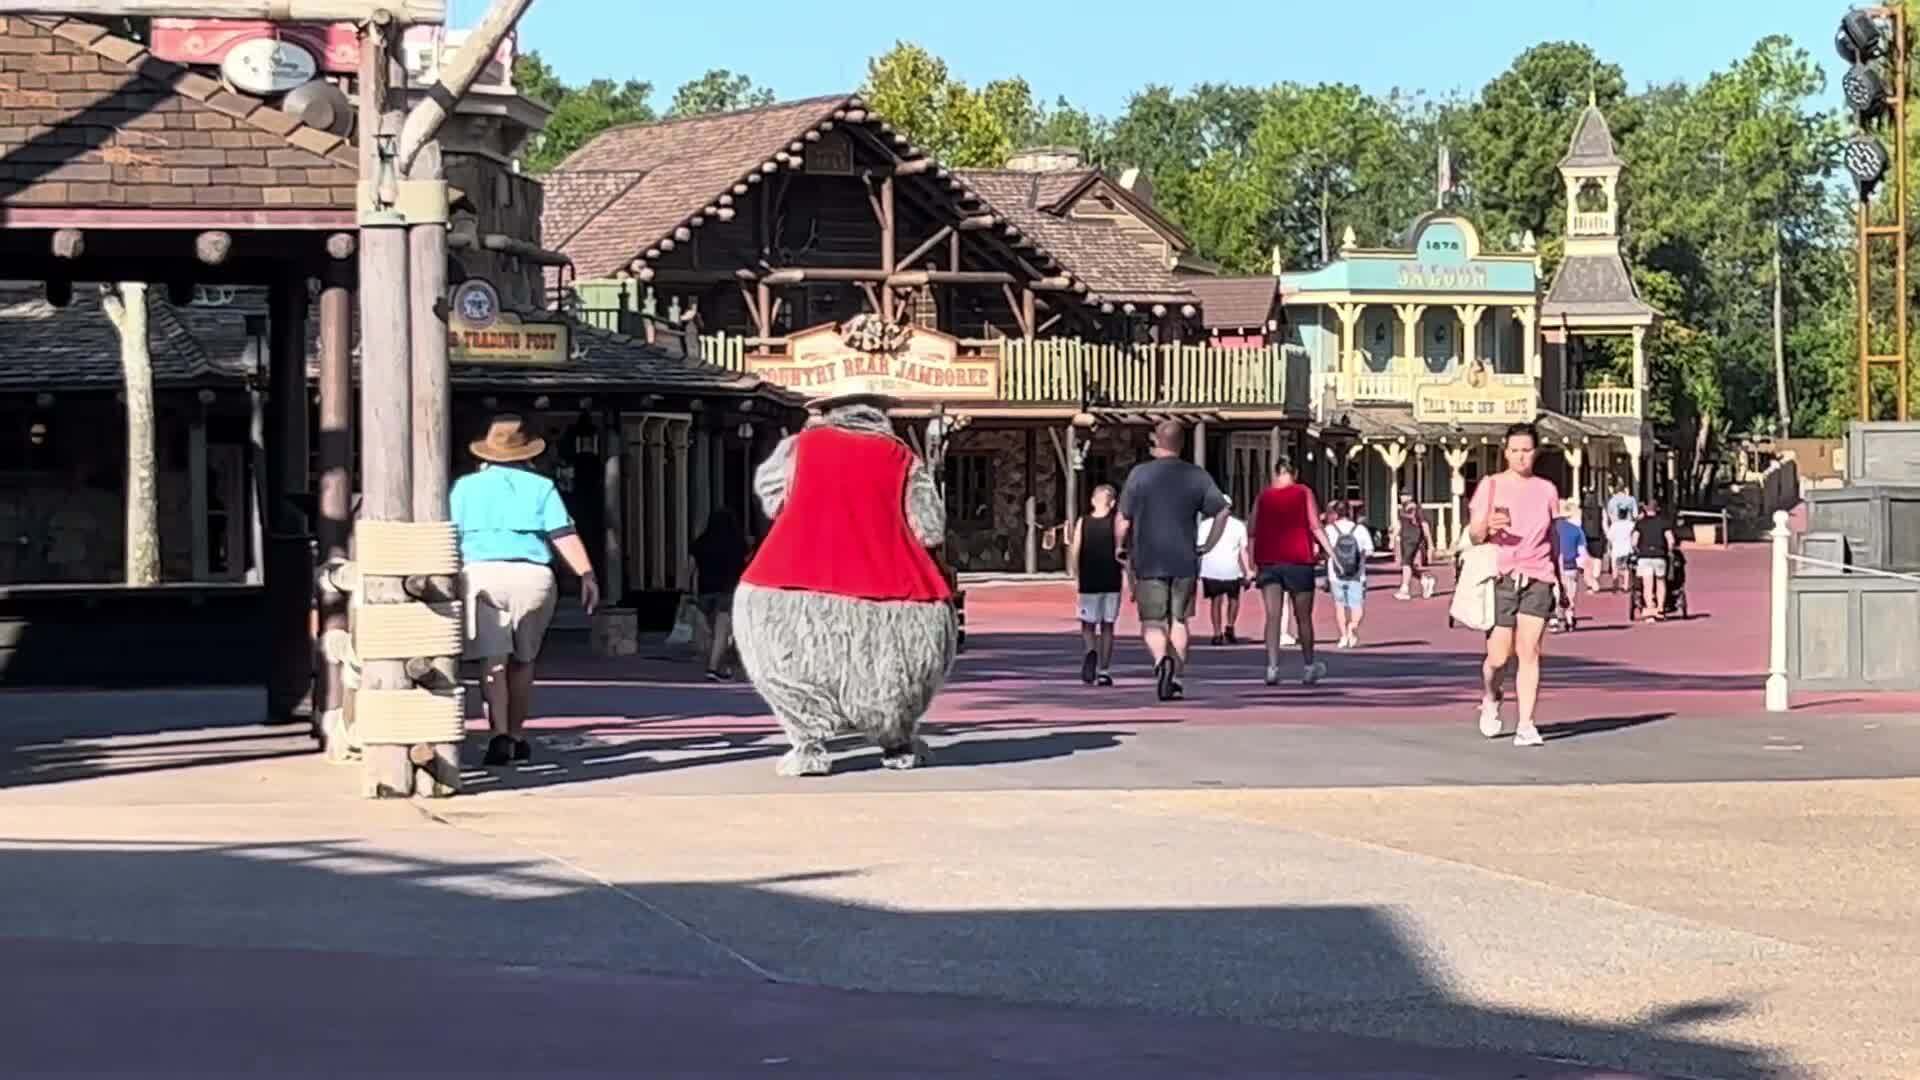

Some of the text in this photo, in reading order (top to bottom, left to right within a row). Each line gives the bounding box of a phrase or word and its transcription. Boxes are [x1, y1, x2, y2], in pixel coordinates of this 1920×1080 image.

[1398, 263, 1487, 289] SALOON
[464, 331, 520, 349] TRADING
[525, 332, 557, 351] POST
[842, 353, 890, 377] BEAR
[896, 360, 989, 387] JAMBOREE
